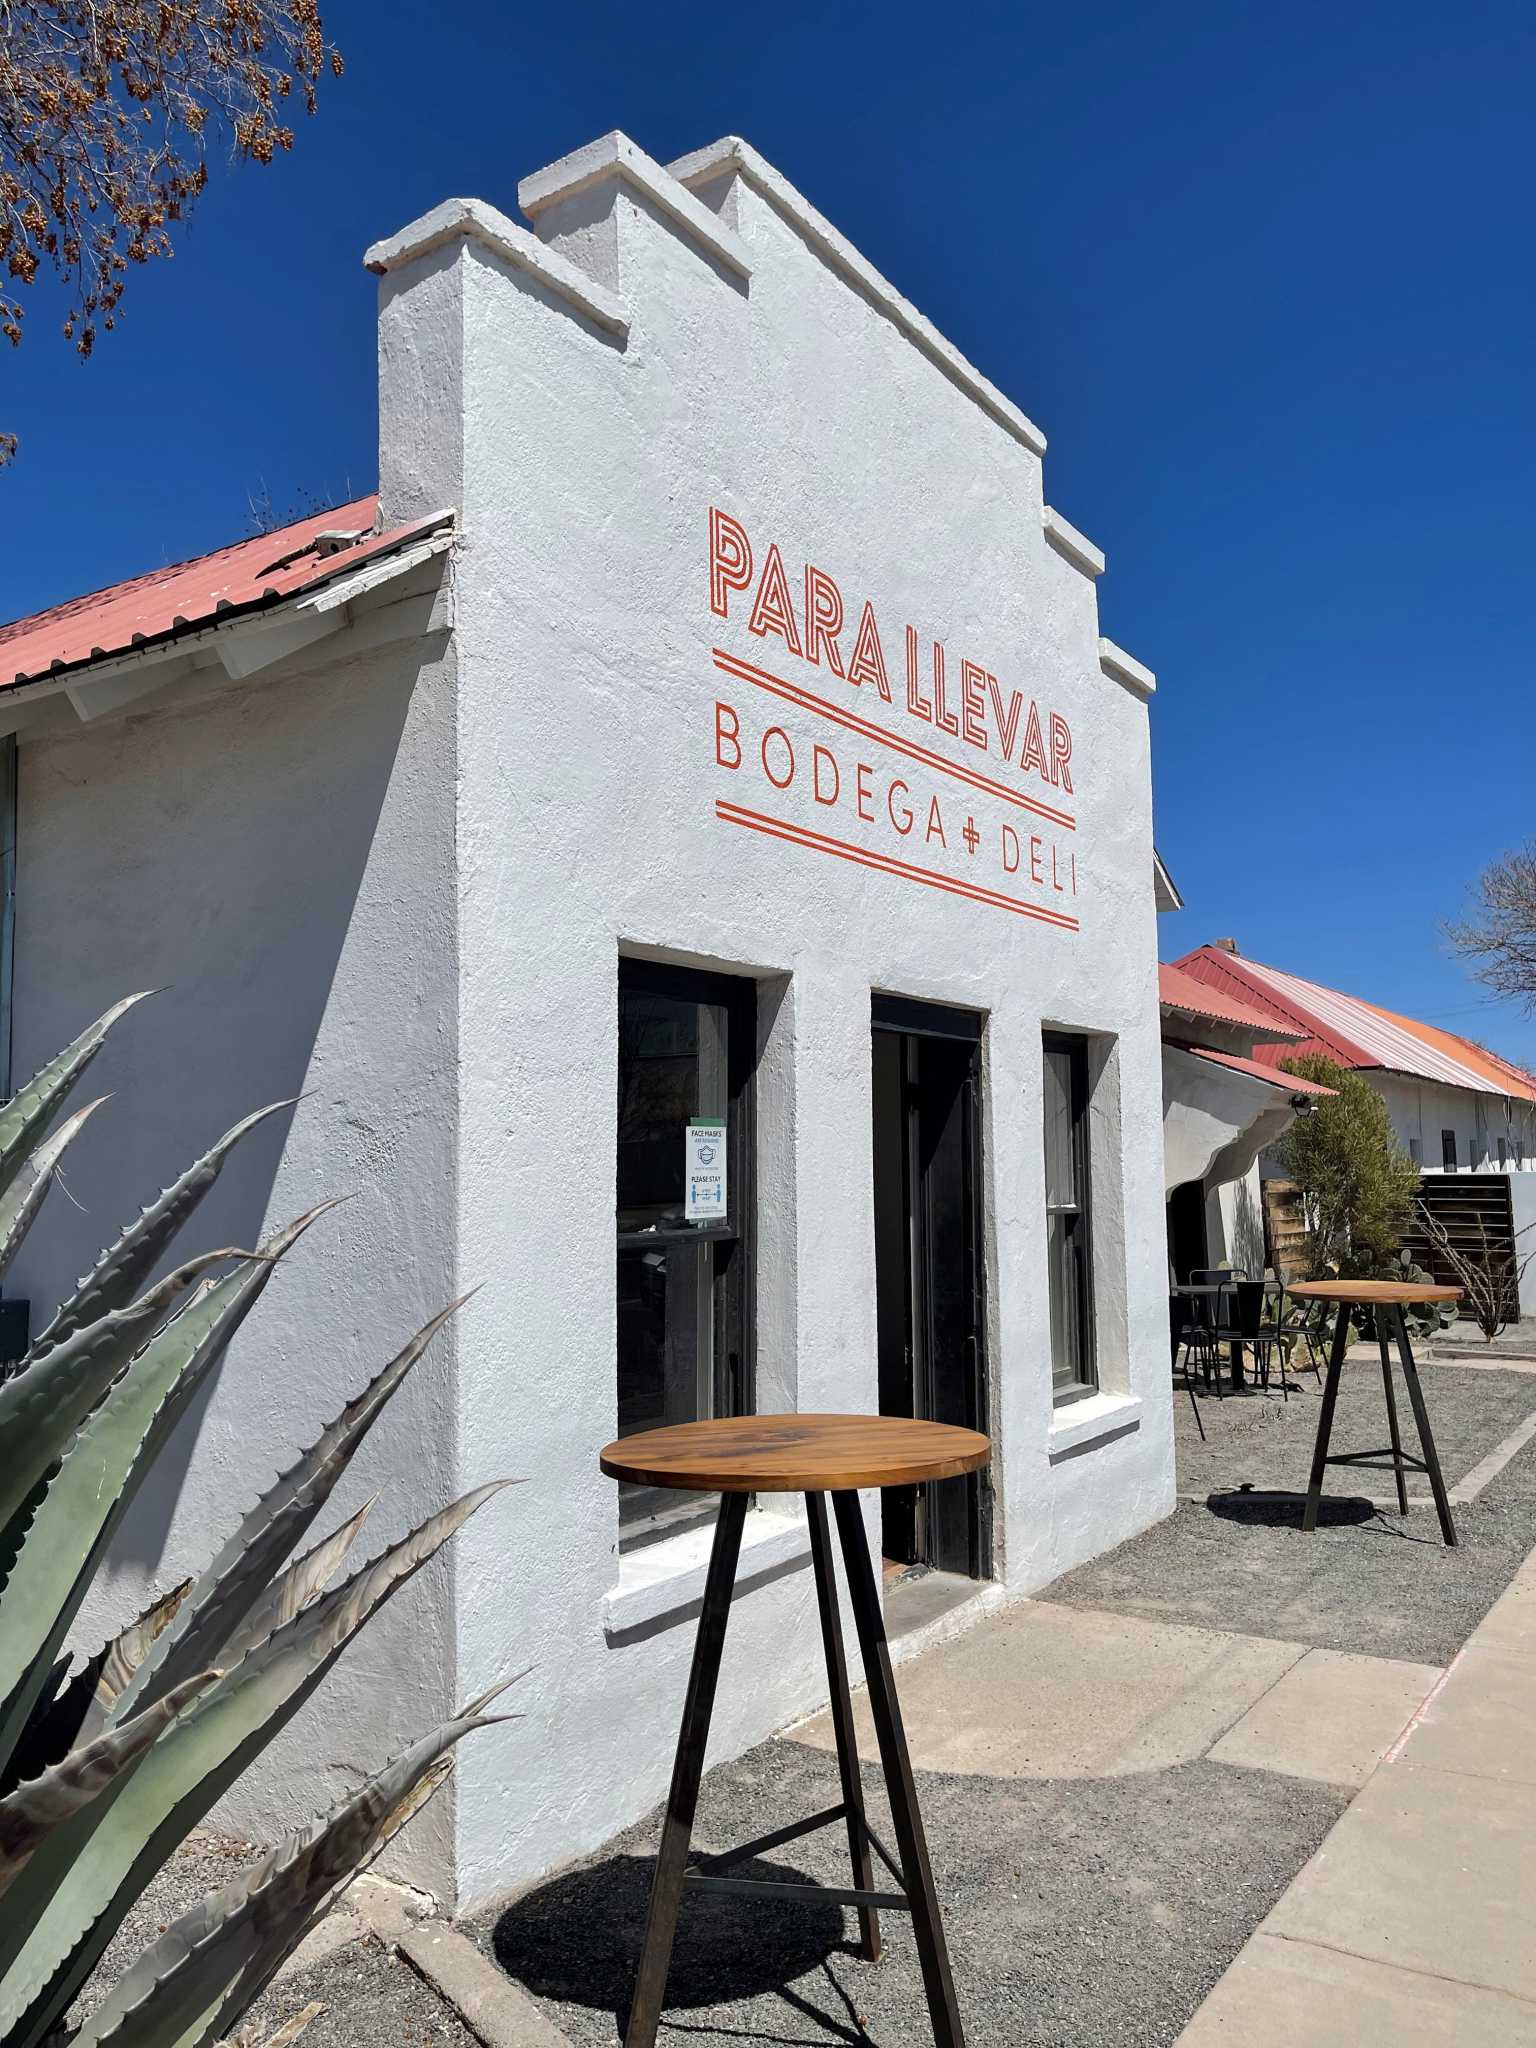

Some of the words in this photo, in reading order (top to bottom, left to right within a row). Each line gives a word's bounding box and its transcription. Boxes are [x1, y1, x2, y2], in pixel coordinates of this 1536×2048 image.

[709, 506, 892, 703] PARA
[906, 624, 1073, 794] LLEVAR
[716, 701, 946, 849] BODEGA
[1002, 824, 1076, 896] DELI
